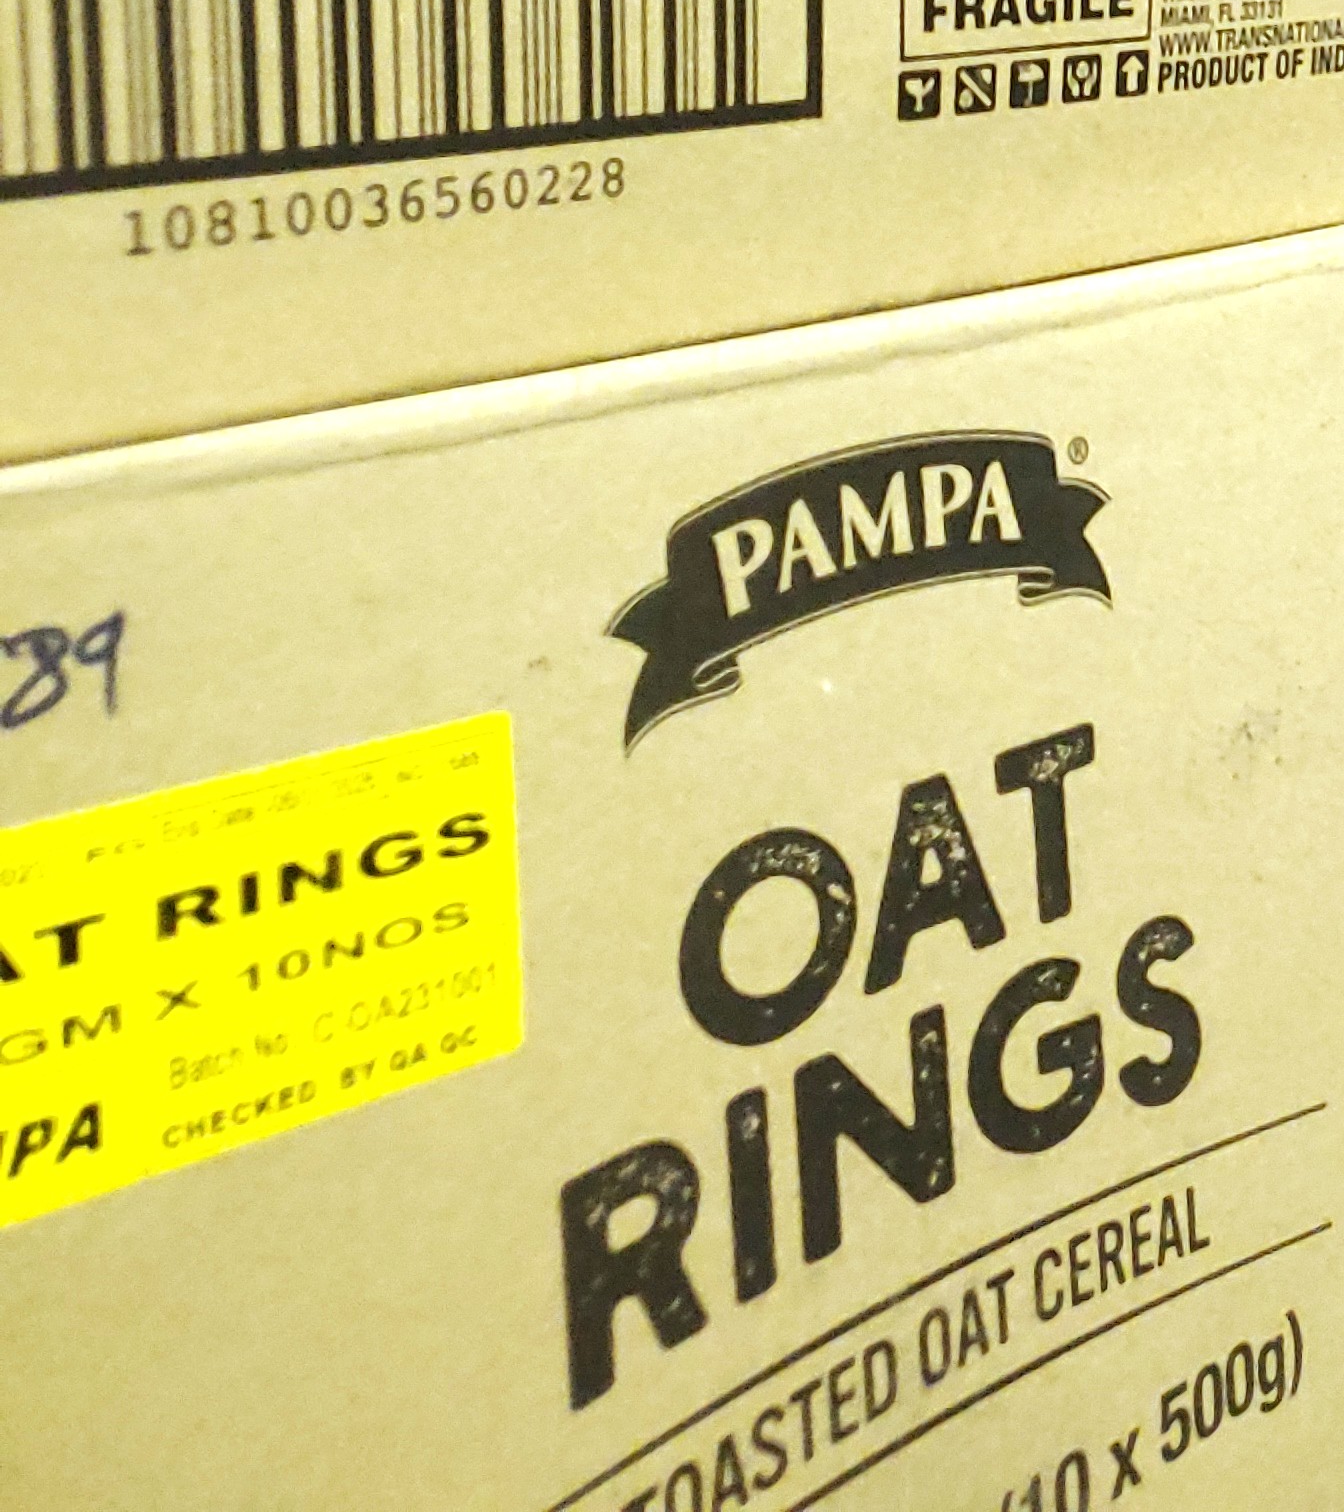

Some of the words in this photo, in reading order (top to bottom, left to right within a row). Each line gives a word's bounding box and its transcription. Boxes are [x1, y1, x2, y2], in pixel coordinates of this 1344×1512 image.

[1157, 55, 1267, 93] PRODUCT
[1275, 52, 1303, 78] OF
[1160, 6, 1213, 28] MIAMI,
[1218, 4, 1235, 23] FL
[124, 158, 628, 259] 10810036560228
[711, 459, 1021, 617] PAMPA
[156, 811, 490, 942] RINGS
[679, 723, 1094, 1046] OAT
[156, 980, 200, 1022] X
[236, 901, 470, 993] 10NOS
[162, 1079, 317, 1150] CHECKED
[340, 1058, 376, 1090] BY
[389, 1041, 427, 1073] QA
[559, 916, 1200, 1409] RINGS
[919, 1270, 1014, 1387] OAT
[1033, 1186, 1211, 1322] CEREAL
[1112, 1428, 1140, 1497] x
[1159, 1310, 1304, 1464] 500g)
